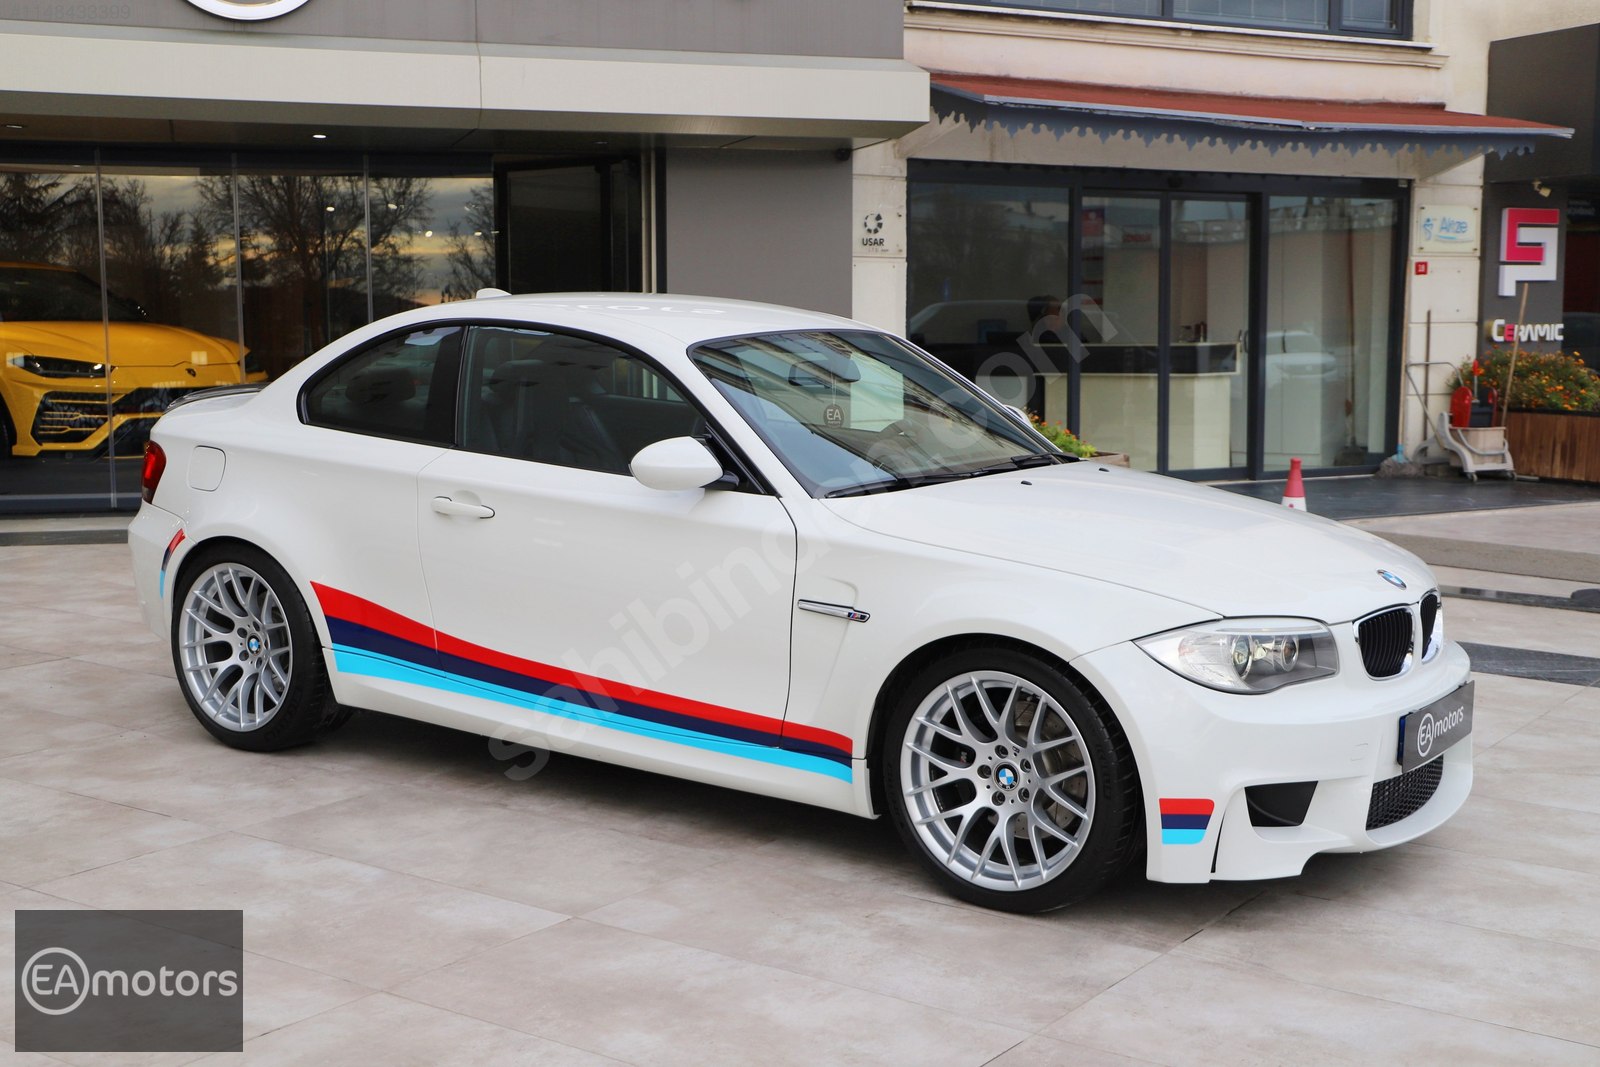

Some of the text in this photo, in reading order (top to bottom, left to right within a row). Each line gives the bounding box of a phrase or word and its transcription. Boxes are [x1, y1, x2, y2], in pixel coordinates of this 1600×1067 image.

[862, 237, 885, 246] USAR
[1492, 319, 1564, 342] CERAMIC
[826, 408, 842, 421] EA
